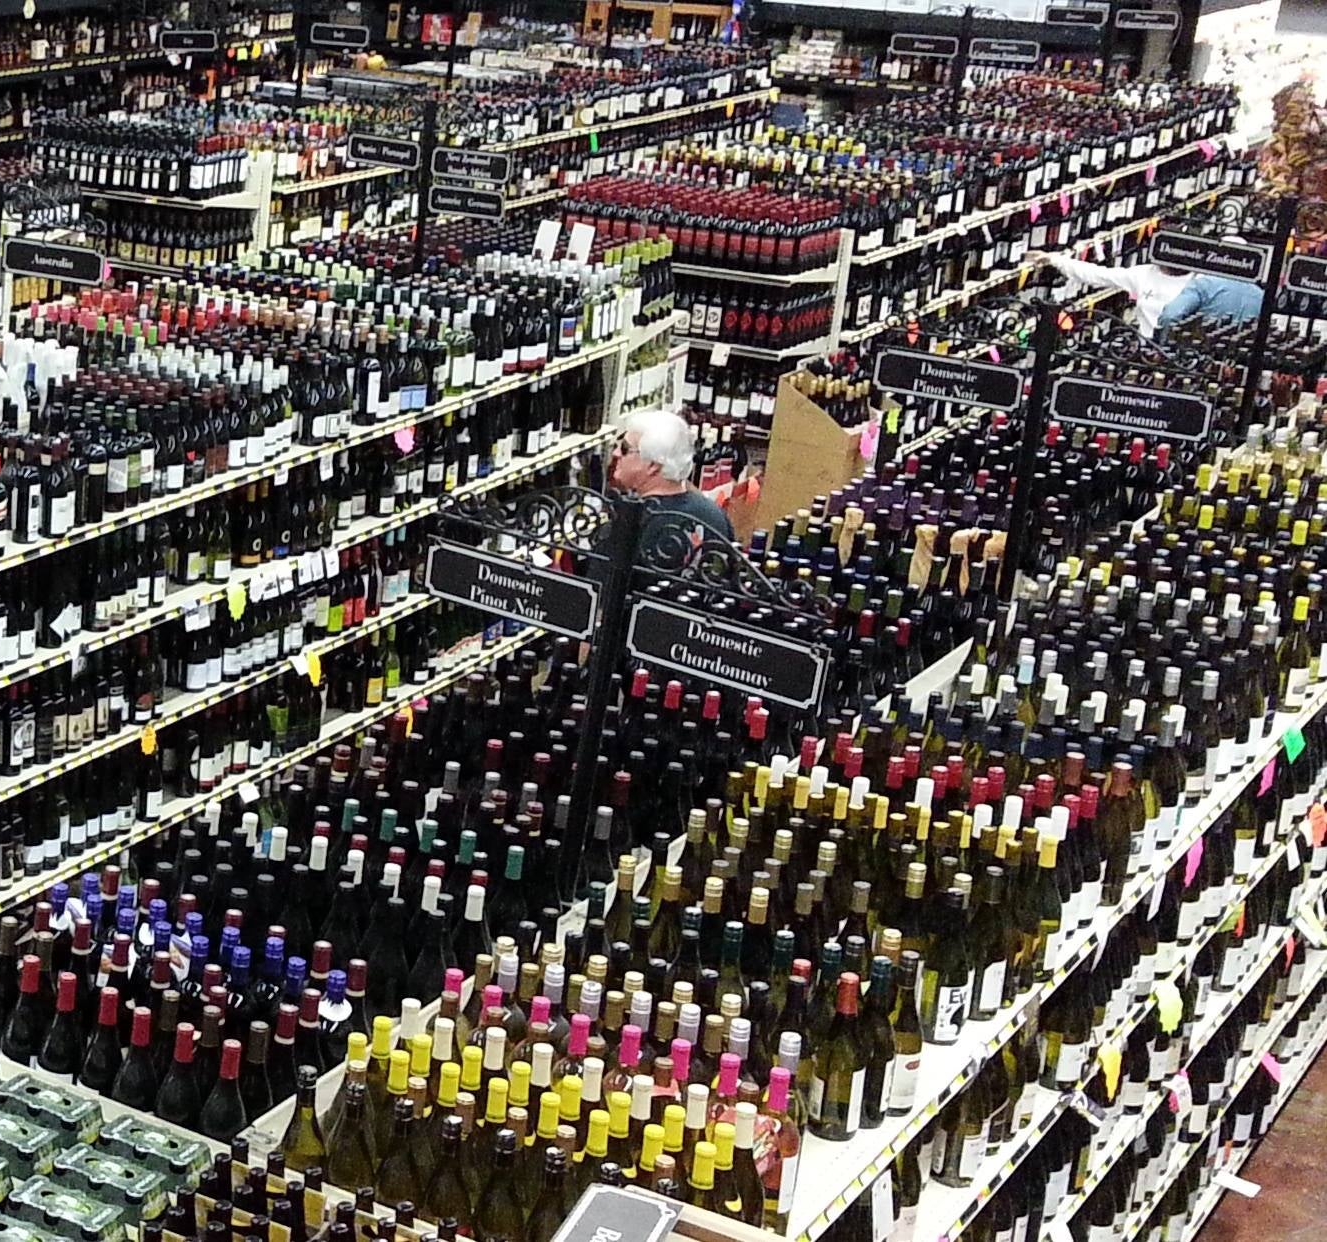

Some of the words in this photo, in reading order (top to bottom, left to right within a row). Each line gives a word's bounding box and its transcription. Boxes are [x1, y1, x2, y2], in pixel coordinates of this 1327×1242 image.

[31, 253, 74, 270] Australia
[1159, 241, 1204, 260] Domestic
[1206, 251, 1255, 271] Zinfandel
[920, 361, 978, 383] Domestic
[913, 378, 947, 398] Pinot
[950, 385, 980, 401] Noir
[1100, 387, 1162, 410] Domestic
[1086, 405, 1173, 431] Chardonnay
[477, 562, 544, 597] Domestic
[470, 584, 511, 614] Pinot
[513, 598, 548, 623] Noir
[687, 621, 764, 659] Domestic
[669, 643, 773, 689] Chardonnay
